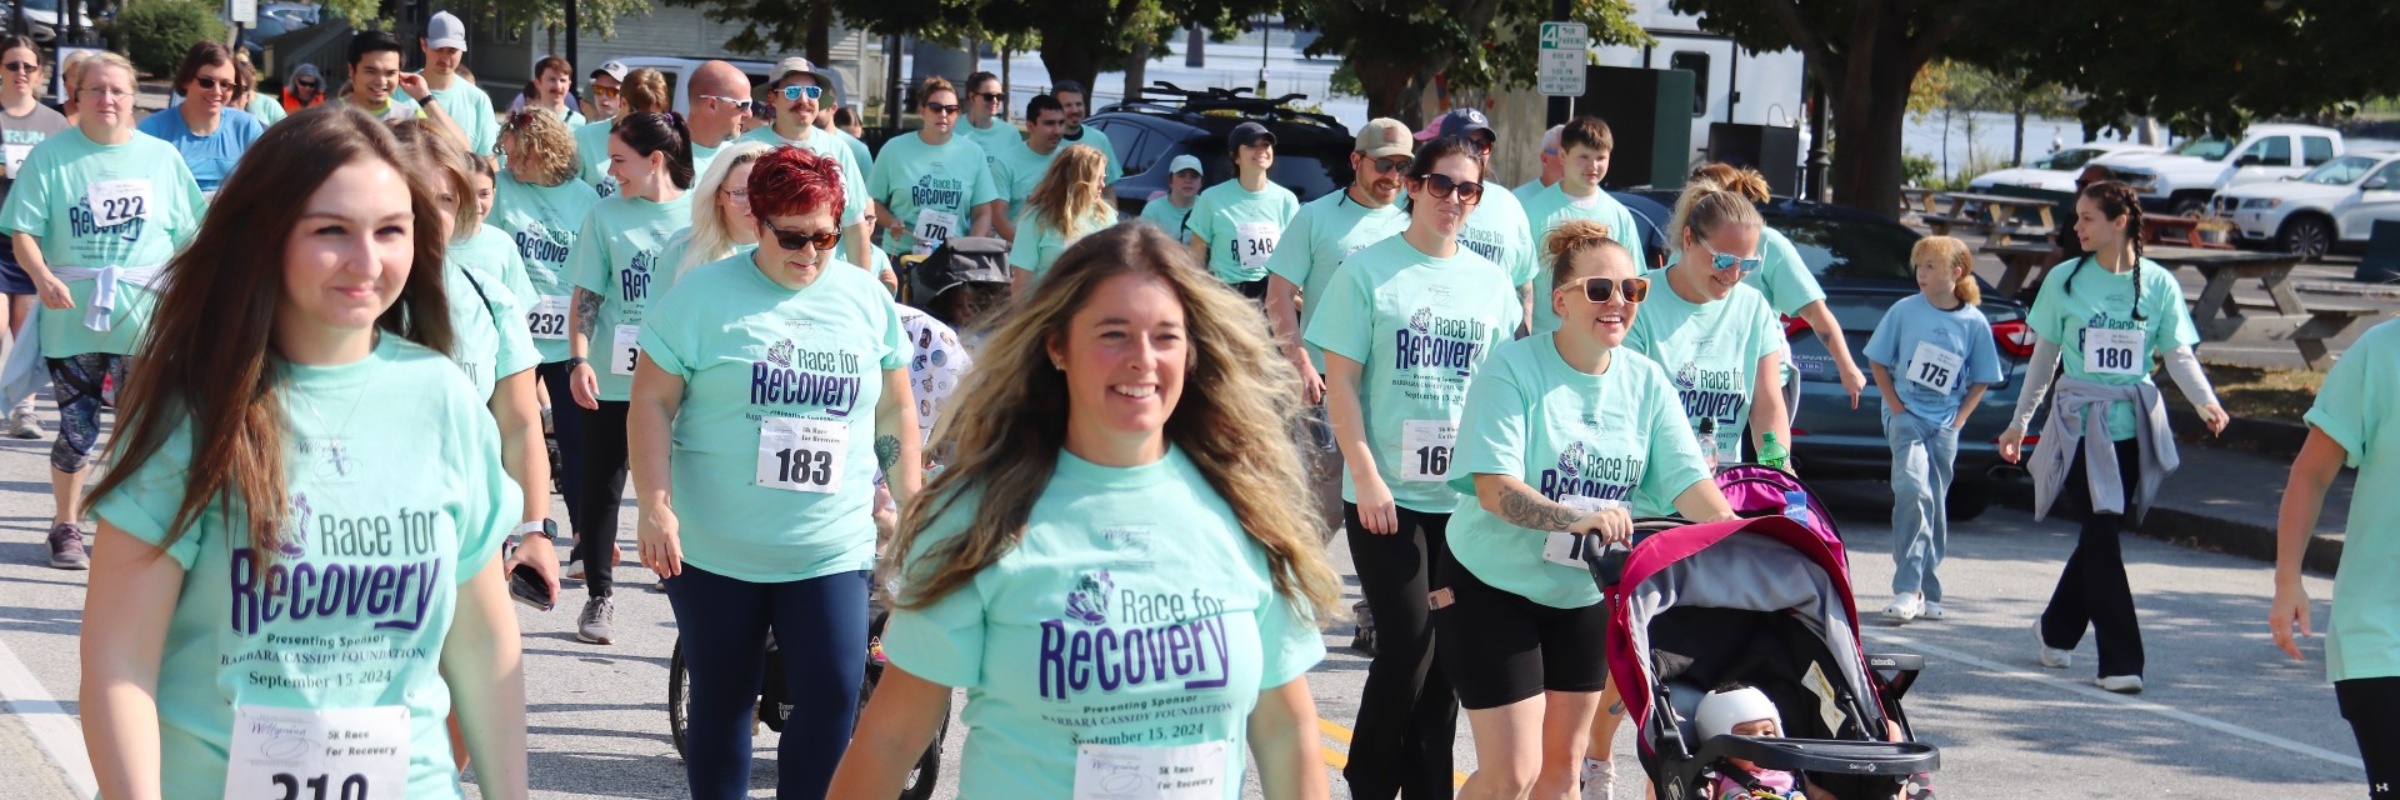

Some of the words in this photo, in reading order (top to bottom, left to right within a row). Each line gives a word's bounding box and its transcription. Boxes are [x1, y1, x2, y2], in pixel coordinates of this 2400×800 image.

[1543, 25, 1558, 48] 4
[103, 196, 147, 221] 222
[912, 186, 963, 209] Recovery
[924, 223, 948, 240] 170
[516, 232, 569, 264] Recove
[1248, 238, 1274, 255] 348
[528, 312, 565, 335] 232
[1435, 317, 1466, 339] Race
[797, 348, 836, 373] Race
[839, 350, 859, 374] for
[1396, 328, 1485, 376] Recovery
[2095, 347, 2132, 369] 180
[1700, 369, 1731, 390] Race
[1919, 362, 1950, 388] 175
[751, 361, 860, 416] Recovery
[775, 448, 833, 486] 183
[1586, 454, 1621, 482] Race
[1625, 454, 1643, 483] for
[319, 513, 393, 557] Race
[399, 507, 440, 556] for
[231, 549, 442, 635] Recovery
[1121, 589, 1186, 624] Race
[1191, 588, 1226, 616] for
[267, 633, 335, 648] Presenting
[339, 634, 386, 648] Sponsor
[1040, 615, 1230, 700] Recovery
[249, 671, 331, 689] September
[359, 670, 392, 685] 2024
[1084, 701, 1147, 714] Presenting
[1151, 695, 1198, 707] Sponsor
[1100, 713, 1150, 726] CASSIDY
[1155, 702, 1235, 720] FOUNDATION
[345, 730, 370, 740] Race
[1149, 728, 1168, 742] 15,
[1173, 723, 1205, 737] 2024
[326, 746, 344, 757] for
[349, 745, 398, 757] Recovery
